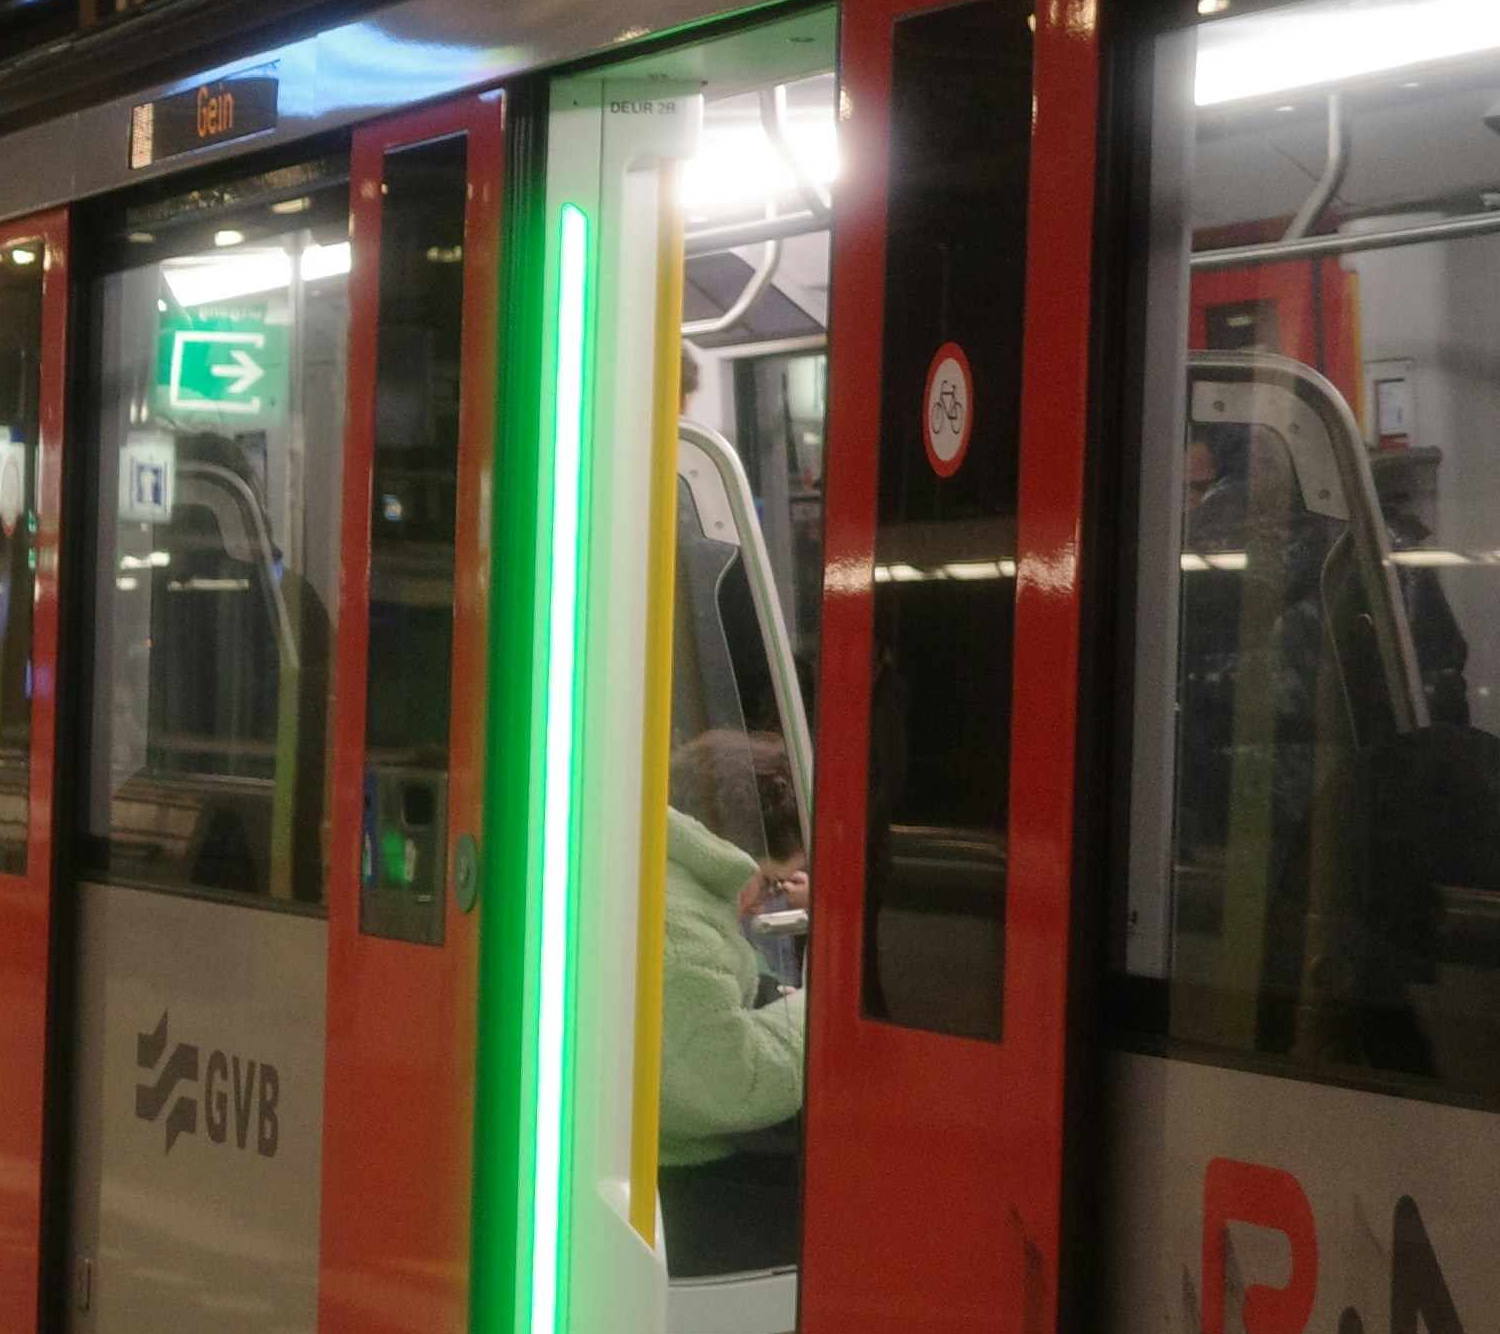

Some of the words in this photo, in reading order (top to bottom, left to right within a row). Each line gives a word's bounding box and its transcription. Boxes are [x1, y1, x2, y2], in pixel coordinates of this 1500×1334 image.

[196, 84, 235, 138] Gein
[610, 101, 653, 114] DEUR
[205, 1049, 280, 1158] GVB
